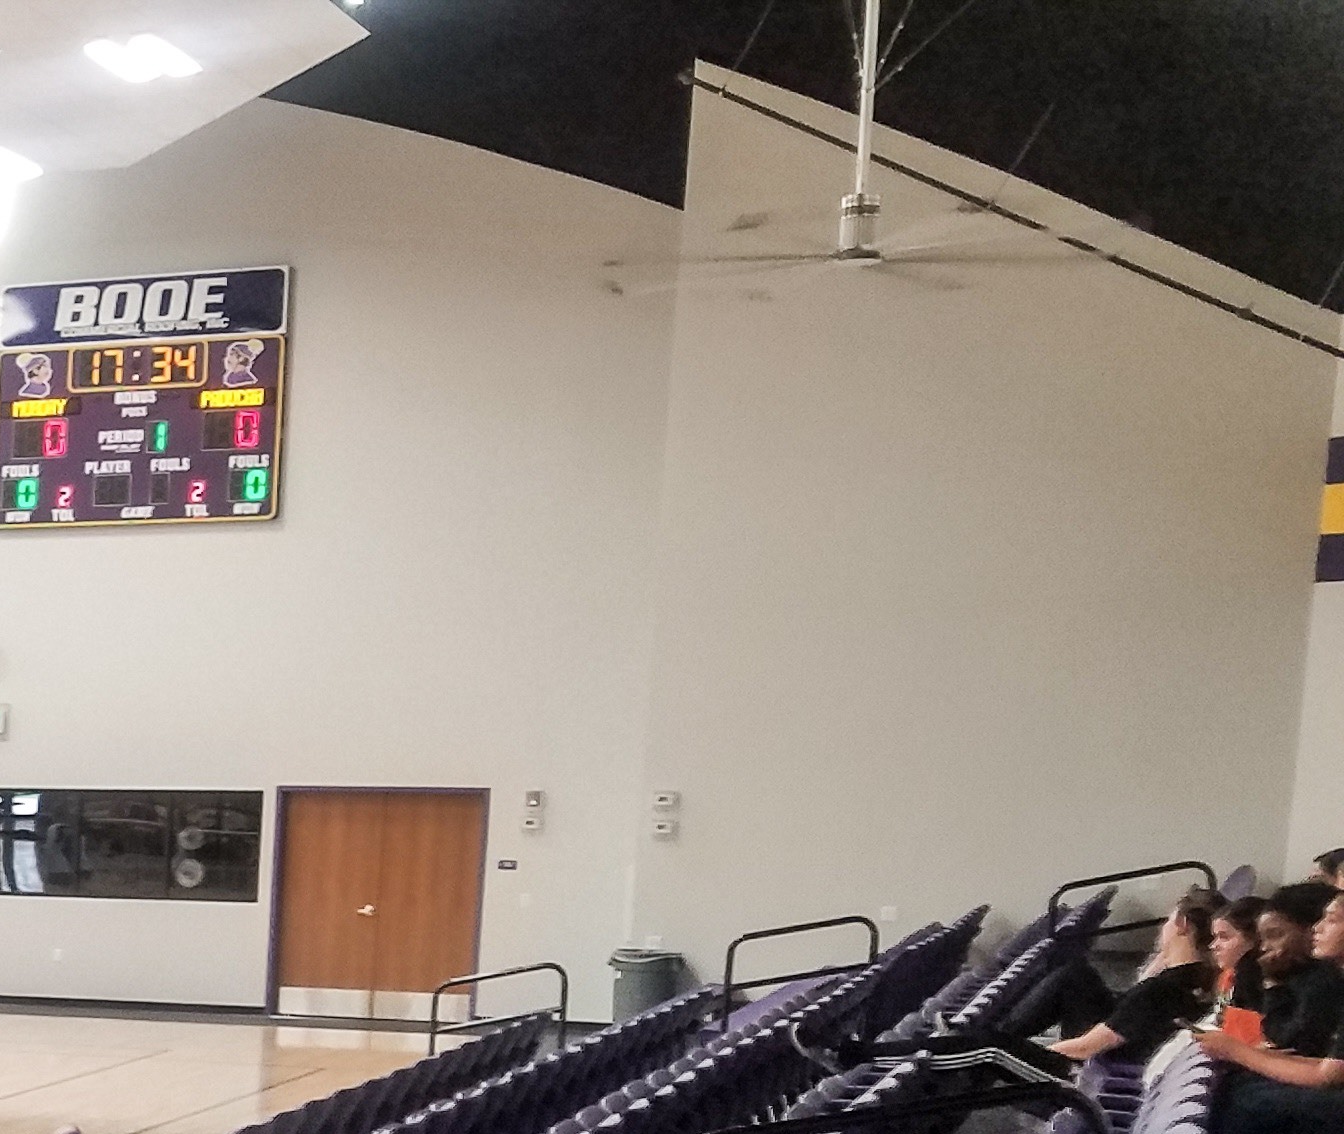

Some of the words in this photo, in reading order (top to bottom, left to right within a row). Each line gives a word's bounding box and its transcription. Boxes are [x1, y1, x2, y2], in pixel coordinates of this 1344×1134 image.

[54, 277, 228, 331] BOOE
[91, 345, 196, 386] 17:34
[43, 418, 68, 457] 0
[234, 410, 260, 448] 0
[57, 486, 73, 508] 2
[190, 481, 206, 503] 2
